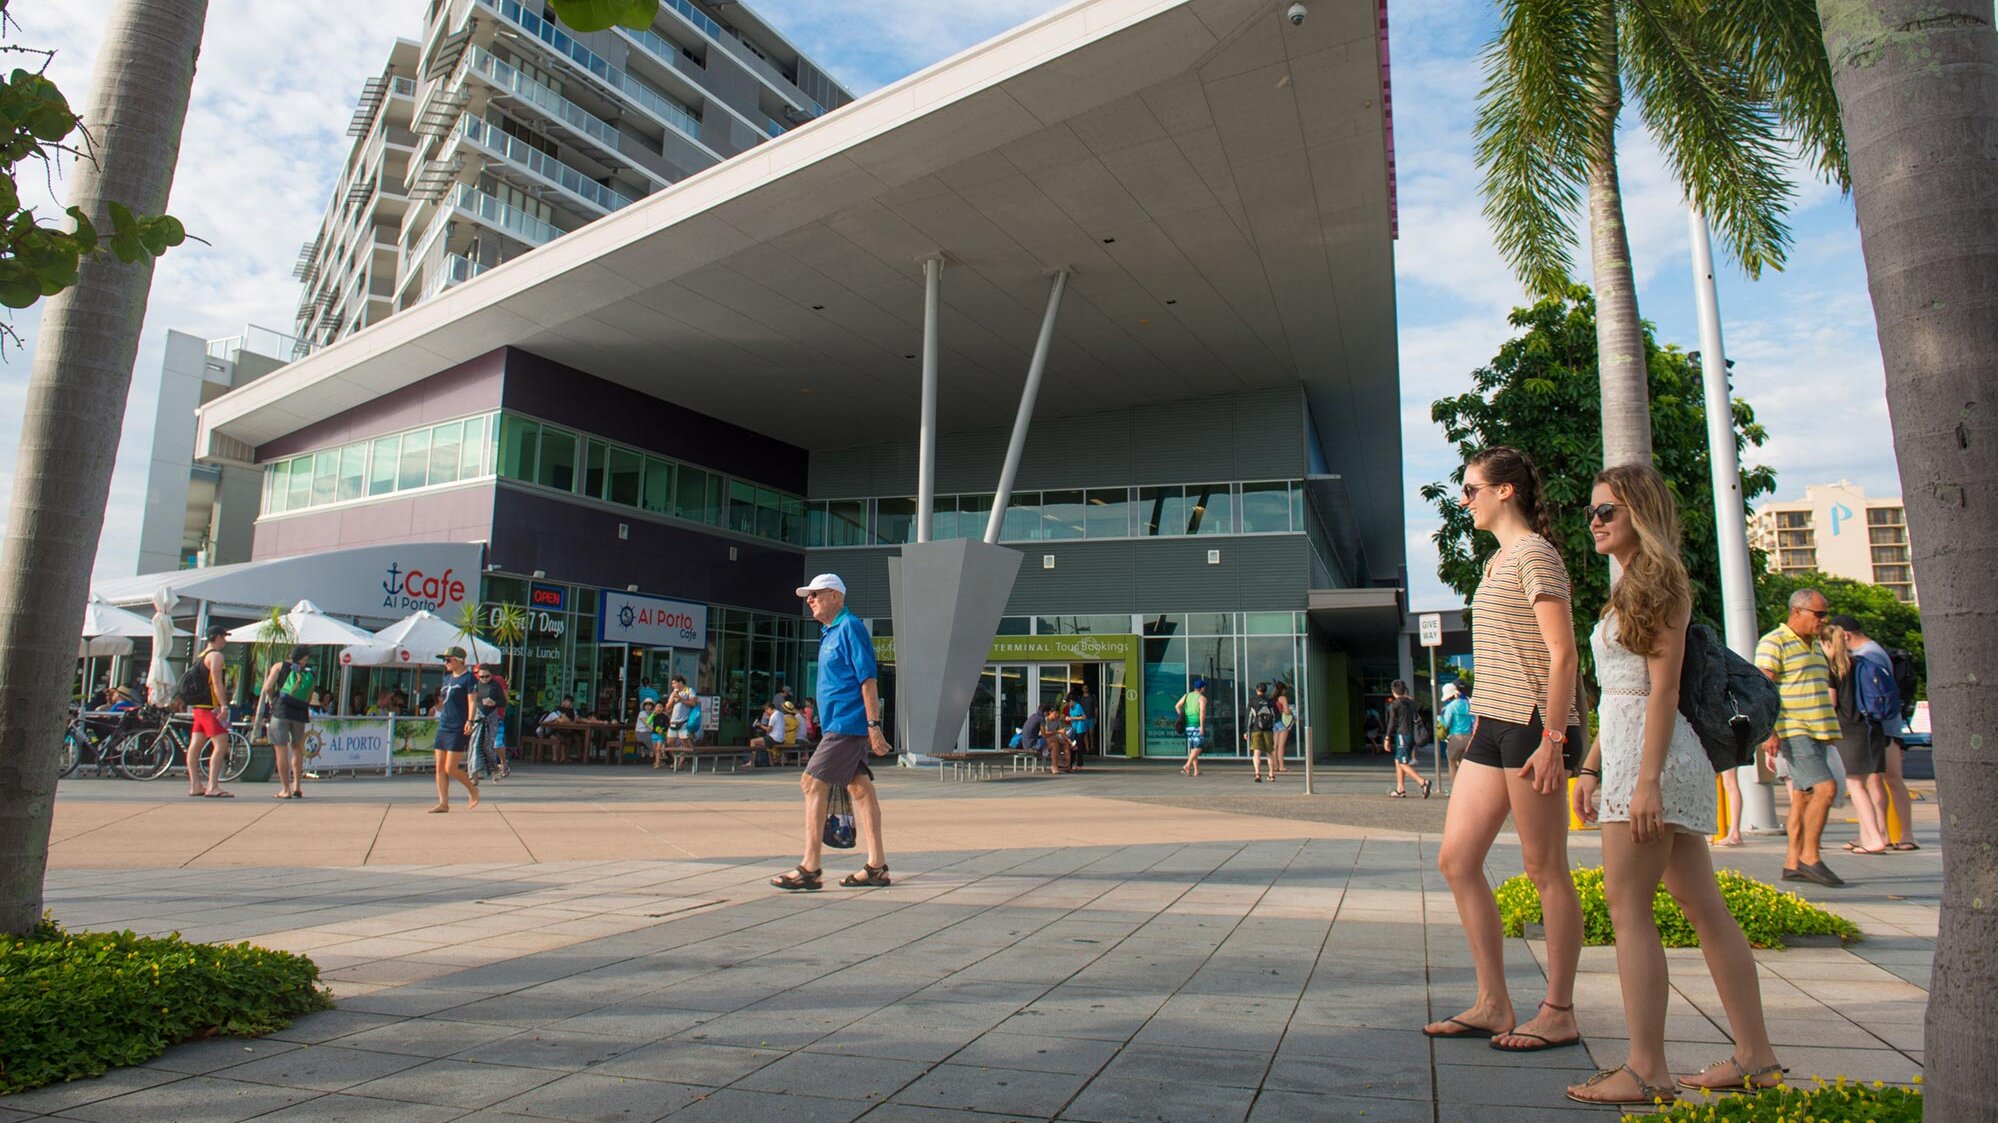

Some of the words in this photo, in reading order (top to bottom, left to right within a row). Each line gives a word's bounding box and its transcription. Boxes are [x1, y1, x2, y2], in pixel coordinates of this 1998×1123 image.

[404, 568, 465, 608] Cafe
[533, 590, 560, 604] OPEN
[401, 597, 435, 612] Porto
[529, 612, 536, 630] 7
[539, 612, 565, 638] Days
[657, 609, 692, 629] Porto
[1422, 620, 1438, 629] GIVE
[679, 628, 697, 641] Cafe
[1423, 631, 1438, 640] WAY
[536, 646, 560, 659] Lunch
[993, 644, 1050, 652] TERMINAL
[1055, 642, 1078, 652] Tour
[1081, 641, 1129, 653] Bookings
[329, 737, 344, 751] AL
[346, 736, 381, 751] PORTO
